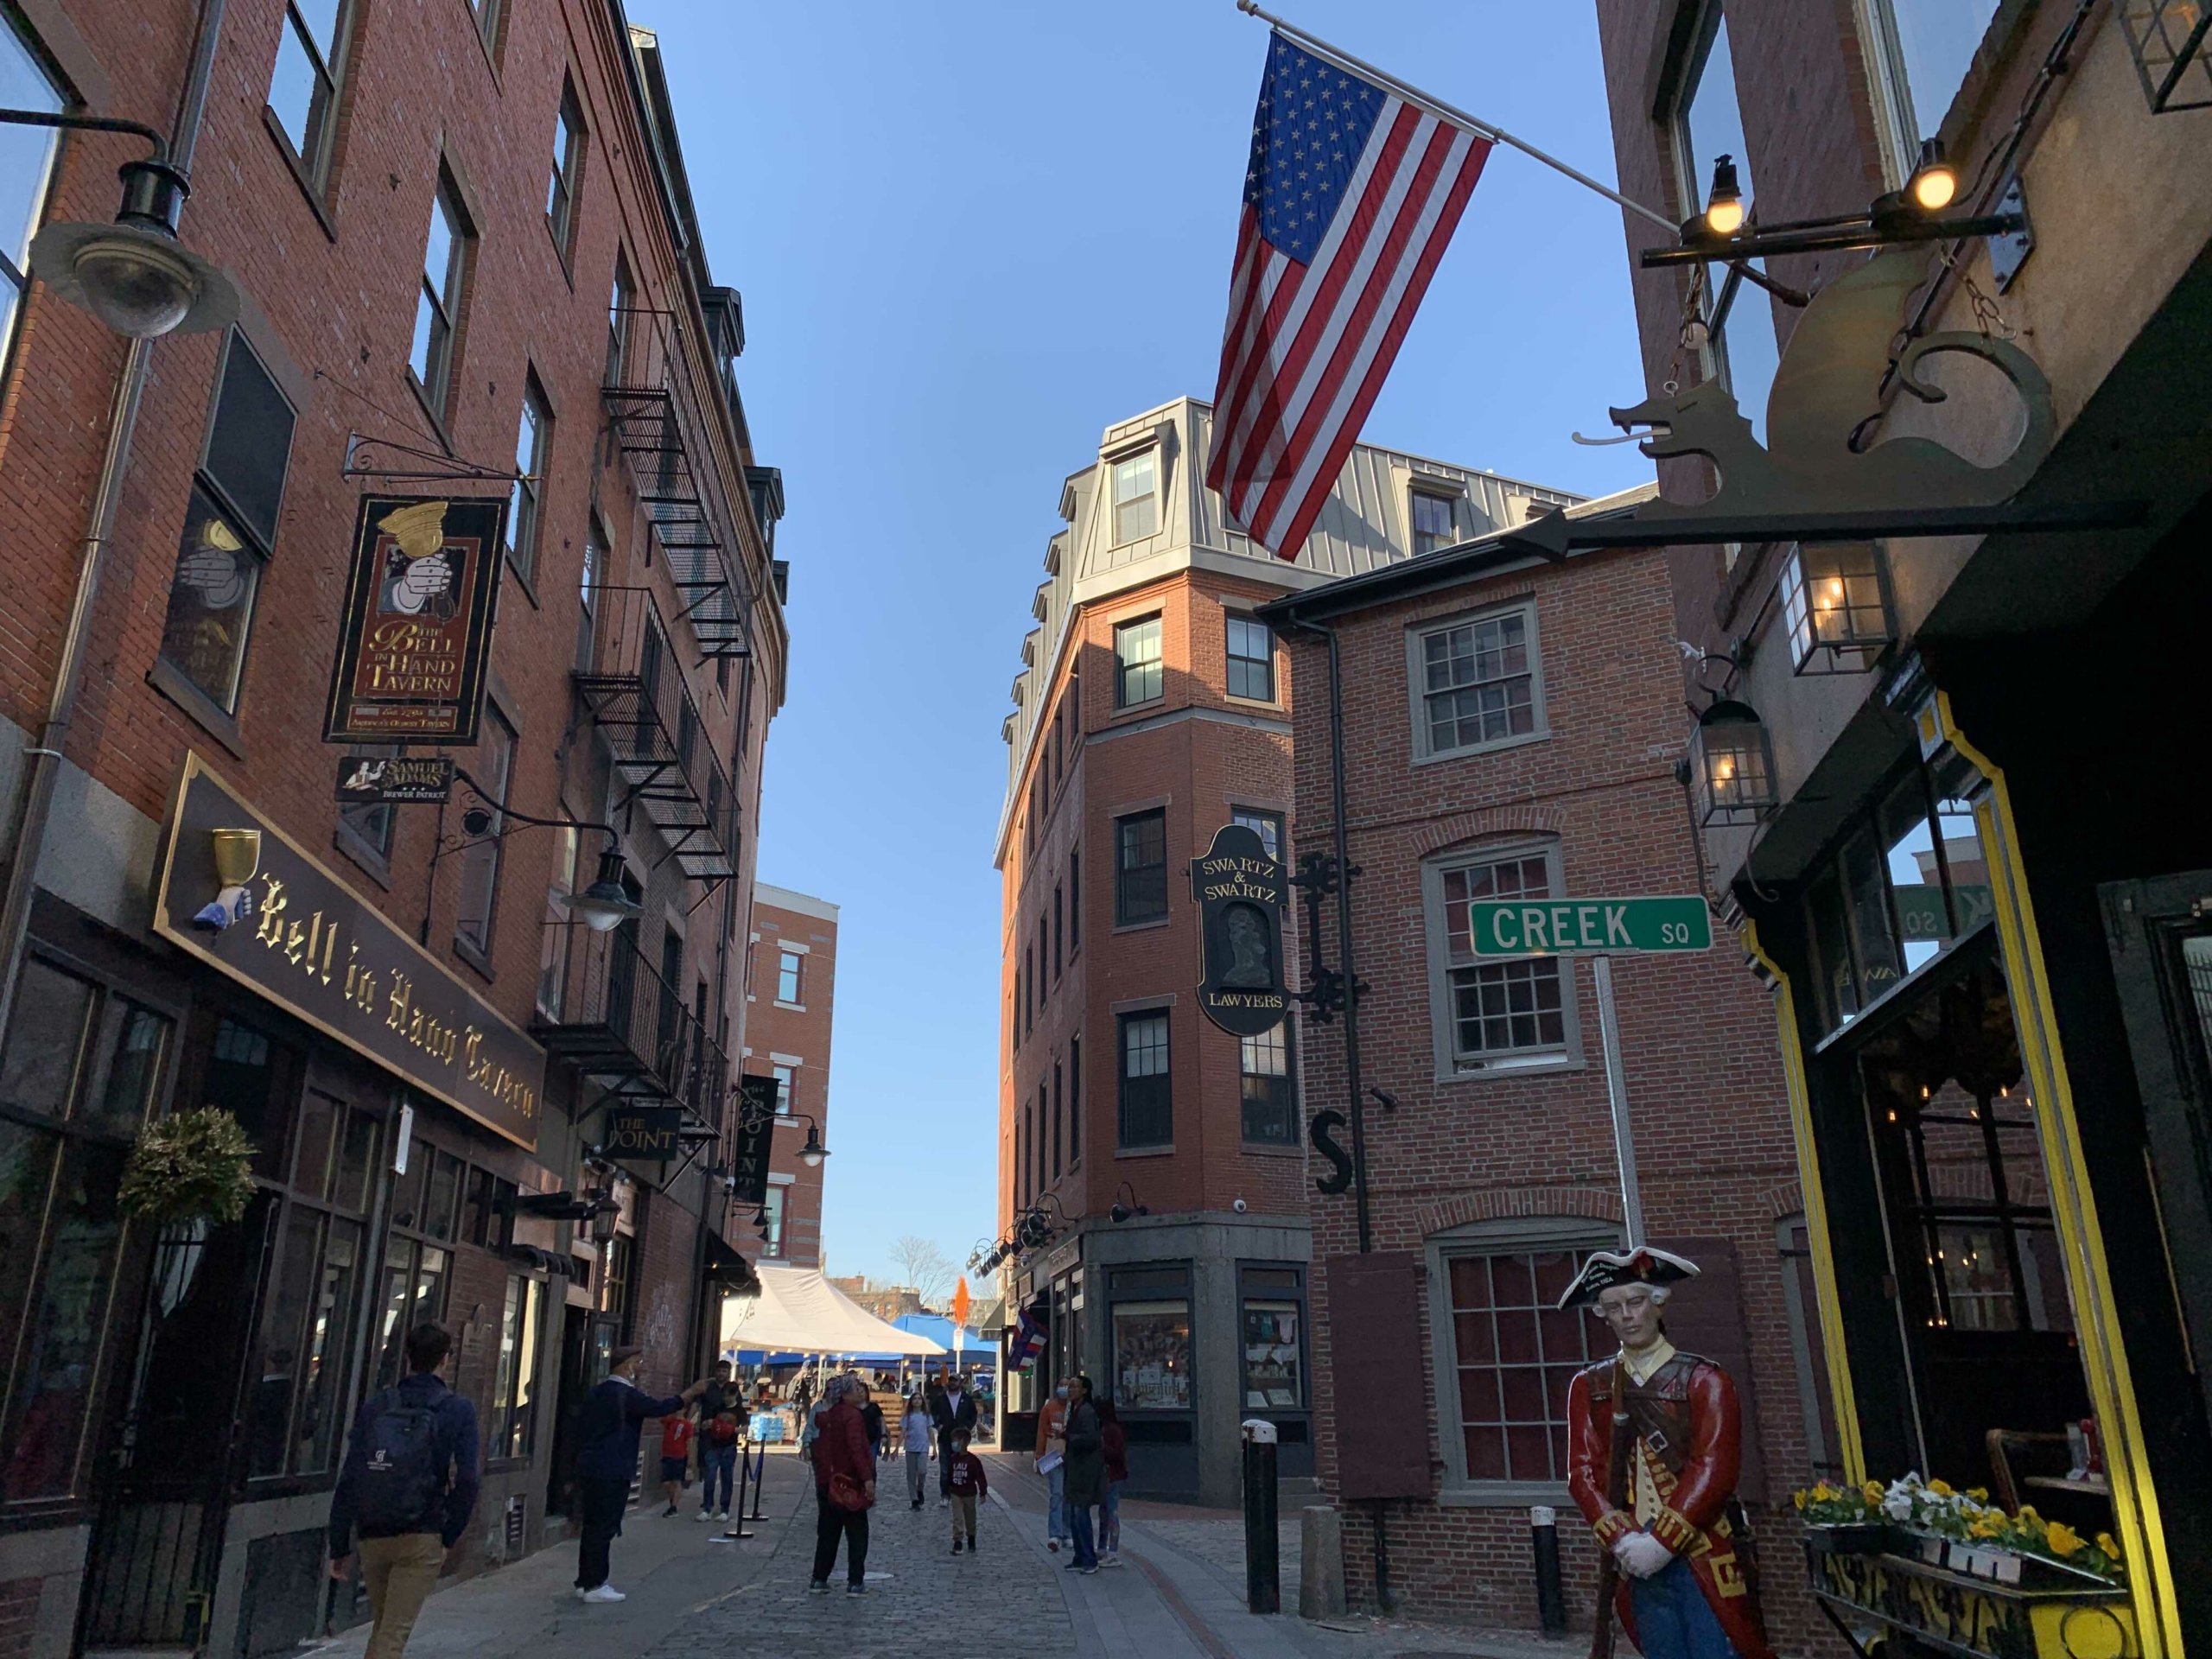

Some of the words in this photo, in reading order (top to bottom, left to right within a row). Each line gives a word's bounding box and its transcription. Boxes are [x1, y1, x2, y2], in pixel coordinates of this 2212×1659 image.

[369, 620, 457, 653] BELL
[389, 654, 455, 675] HAND
[366, 664, 452, 690] TAVERN
[387, 759, 449, 775] SAMUEL
[386, 772, 442, 788] ADAMS
[383, 790, 415, 799] BREWER
[416, 790, 448, 799] PATRIOT
[1202, 857, 1275, 879] SWARTZ
[1233, 871, 1246, 884] &
[1205, 883, 1276, 904] SWARTZ
[1492, 906, 1633, 949] CREEK
[1661, 922, 1690, 944] SQ
[256, 873, 338, 986] Bell
[345, 938, 378, 1014] in
[1209, 993, 1283, 1008] LAWYERS
[618, 1117, 645, 1129] THE
[609, 1127, 676, 1152] POINT
